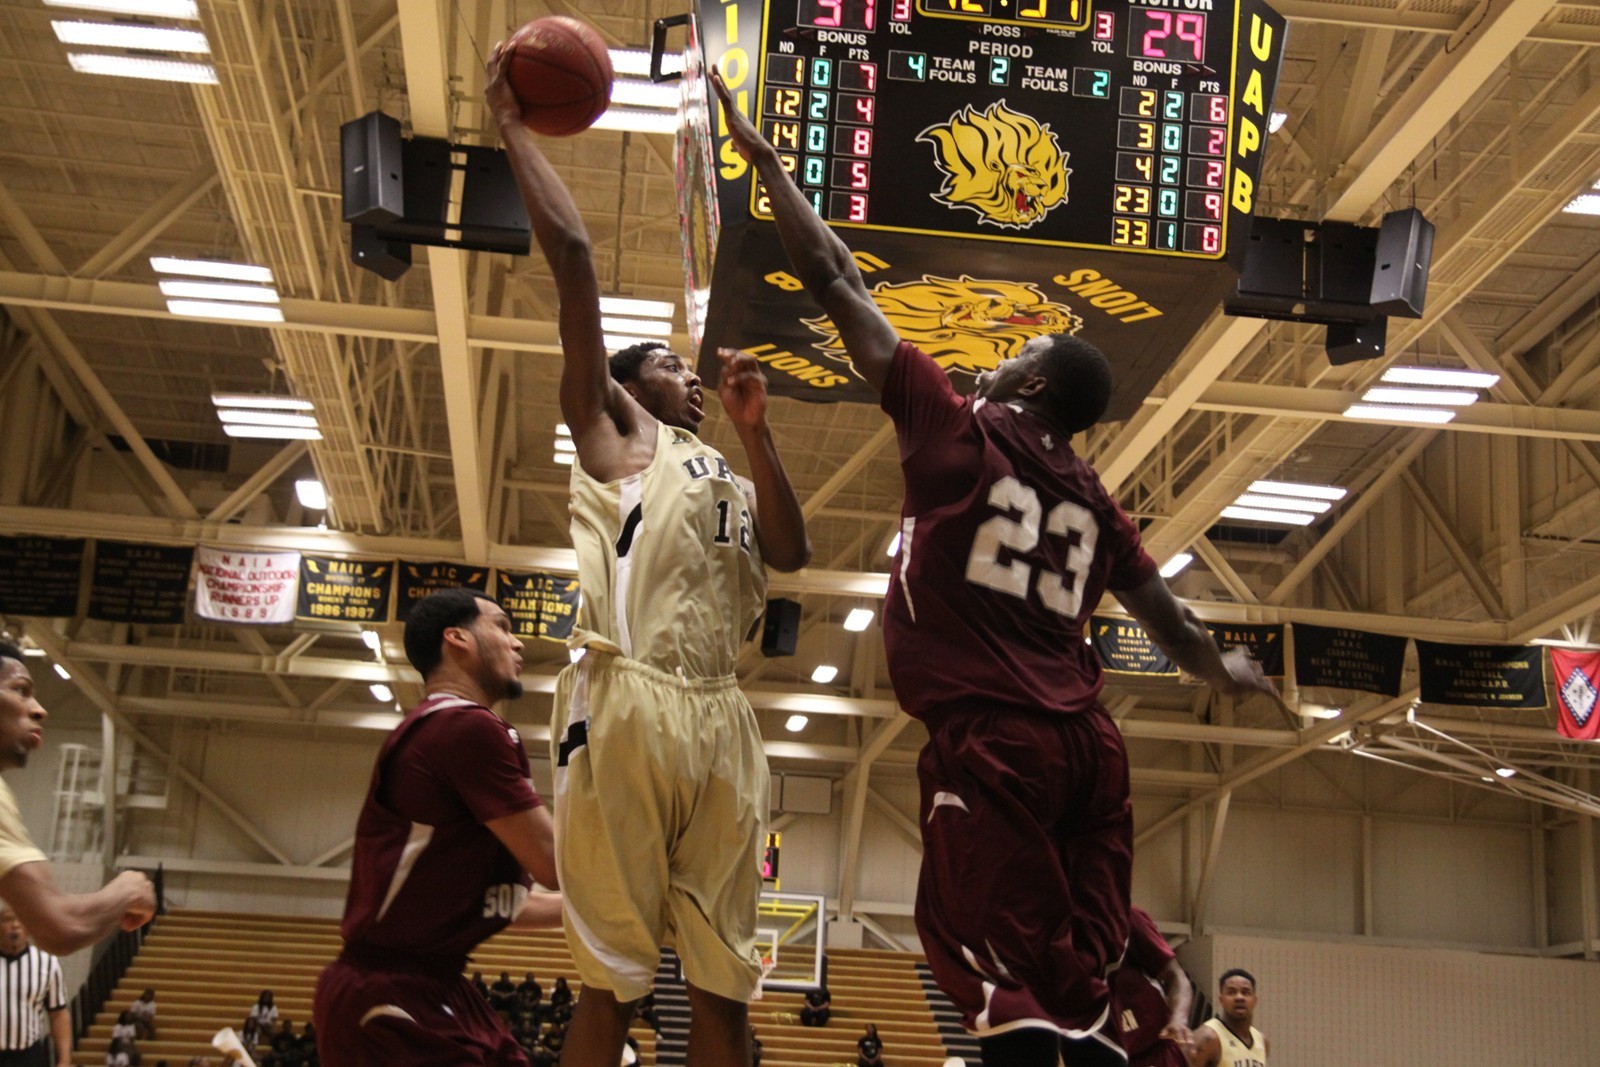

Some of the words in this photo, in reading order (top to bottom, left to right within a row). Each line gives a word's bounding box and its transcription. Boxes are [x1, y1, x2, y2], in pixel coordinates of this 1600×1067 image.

[817, 30, 867, 46] BONUS
[888, 22, 912, 35] TOL
[983, 24, 1021, 38] POSS
[1096, 13, 1112, 38] 3
[1143, 10, 1203, 60] 29
[779, 42, 795, 53] NO
[819, 45, 827, 56] F
[848, 48, 870, 61] PTS
[968, 41, 1033, 58] PERIOD
[1091, 41, 1114, 54] TOL
[796, 58, 803, 83] 1
[812, 60, 830, 86] 0
[860, 64, 874, 90] 7
[908, 55, 924, 80] 4
[929, 69, 977, 84] FOULS
[933, 57, 975, 71] TEAM
[991, 58, 1008, 84] 2
[1025, 65, 1067, 79] TEAM
[1133, 60, 1182, 75] BONUS
[717, 0, 751, 180] IONS
[1021, 78, 1069, 92] FOULS
[1092, 71, 1108, 96] 2
[1132, 75, 1147, 87] NO
[1171, 78, 1178, 89] F
[1199, 81, 1220, 93] PTS
[775, 89, 800, 116] 12
[810, 92, 828, 118] 2
[856, 98, 873, 123] 4
[1138, 91, 1155, 116] 2
[1165, 93, 1182, 118] 2
[1210, 97, 1225, 122] 6
[1231, 13, 1273, 214] UAPB
[772, 122, 798, 149] 14
[809, 124, 826, 151] 0
[853, 129, 871, 156] 8
[1137, 123, 1153, 148] 3
[1163, 125, 1180, 151] 0
[1208, 129, 1224, 154] 2
[806, 157, 823, 184] 0
[851, 162, 867, 188] 5
[1135, 156, 1151, 181] 4
[1162, 158, 1178, 184] 2
[1206, 162, 1223, 187] 2
[849, 193, 866, 222] 3
[1117, 186, 1150, 214] 23
[1160, 189, 1177, 216] 0
[1204, 194, 1221, 219] 9
[1114, 218, 1148, 246] 33
[1167, 223, 1175, 248] 1
[1202, 227, 1219, 252] 0
[1053, 268, 1164, 323] LIONS
[740, 343, 849, 388] LIONS
[965, 475, 1099, 620] 23
[199, 563, 242, 580] NATIONAL
[248, 570, 297, 580] OUTDOOR
[328, 561, 363, 576] NAIA
[206, 578, 286, 593] CHAMPIONSHIP
[306, 582, 382, 600] CHAMPIONS
[211, 591, 260, 606] RUNNERS
[265, 595, 279, 605] UP
[520, 621, 548, 634] 196
[1224, 631, 1257, 643] NAIA
